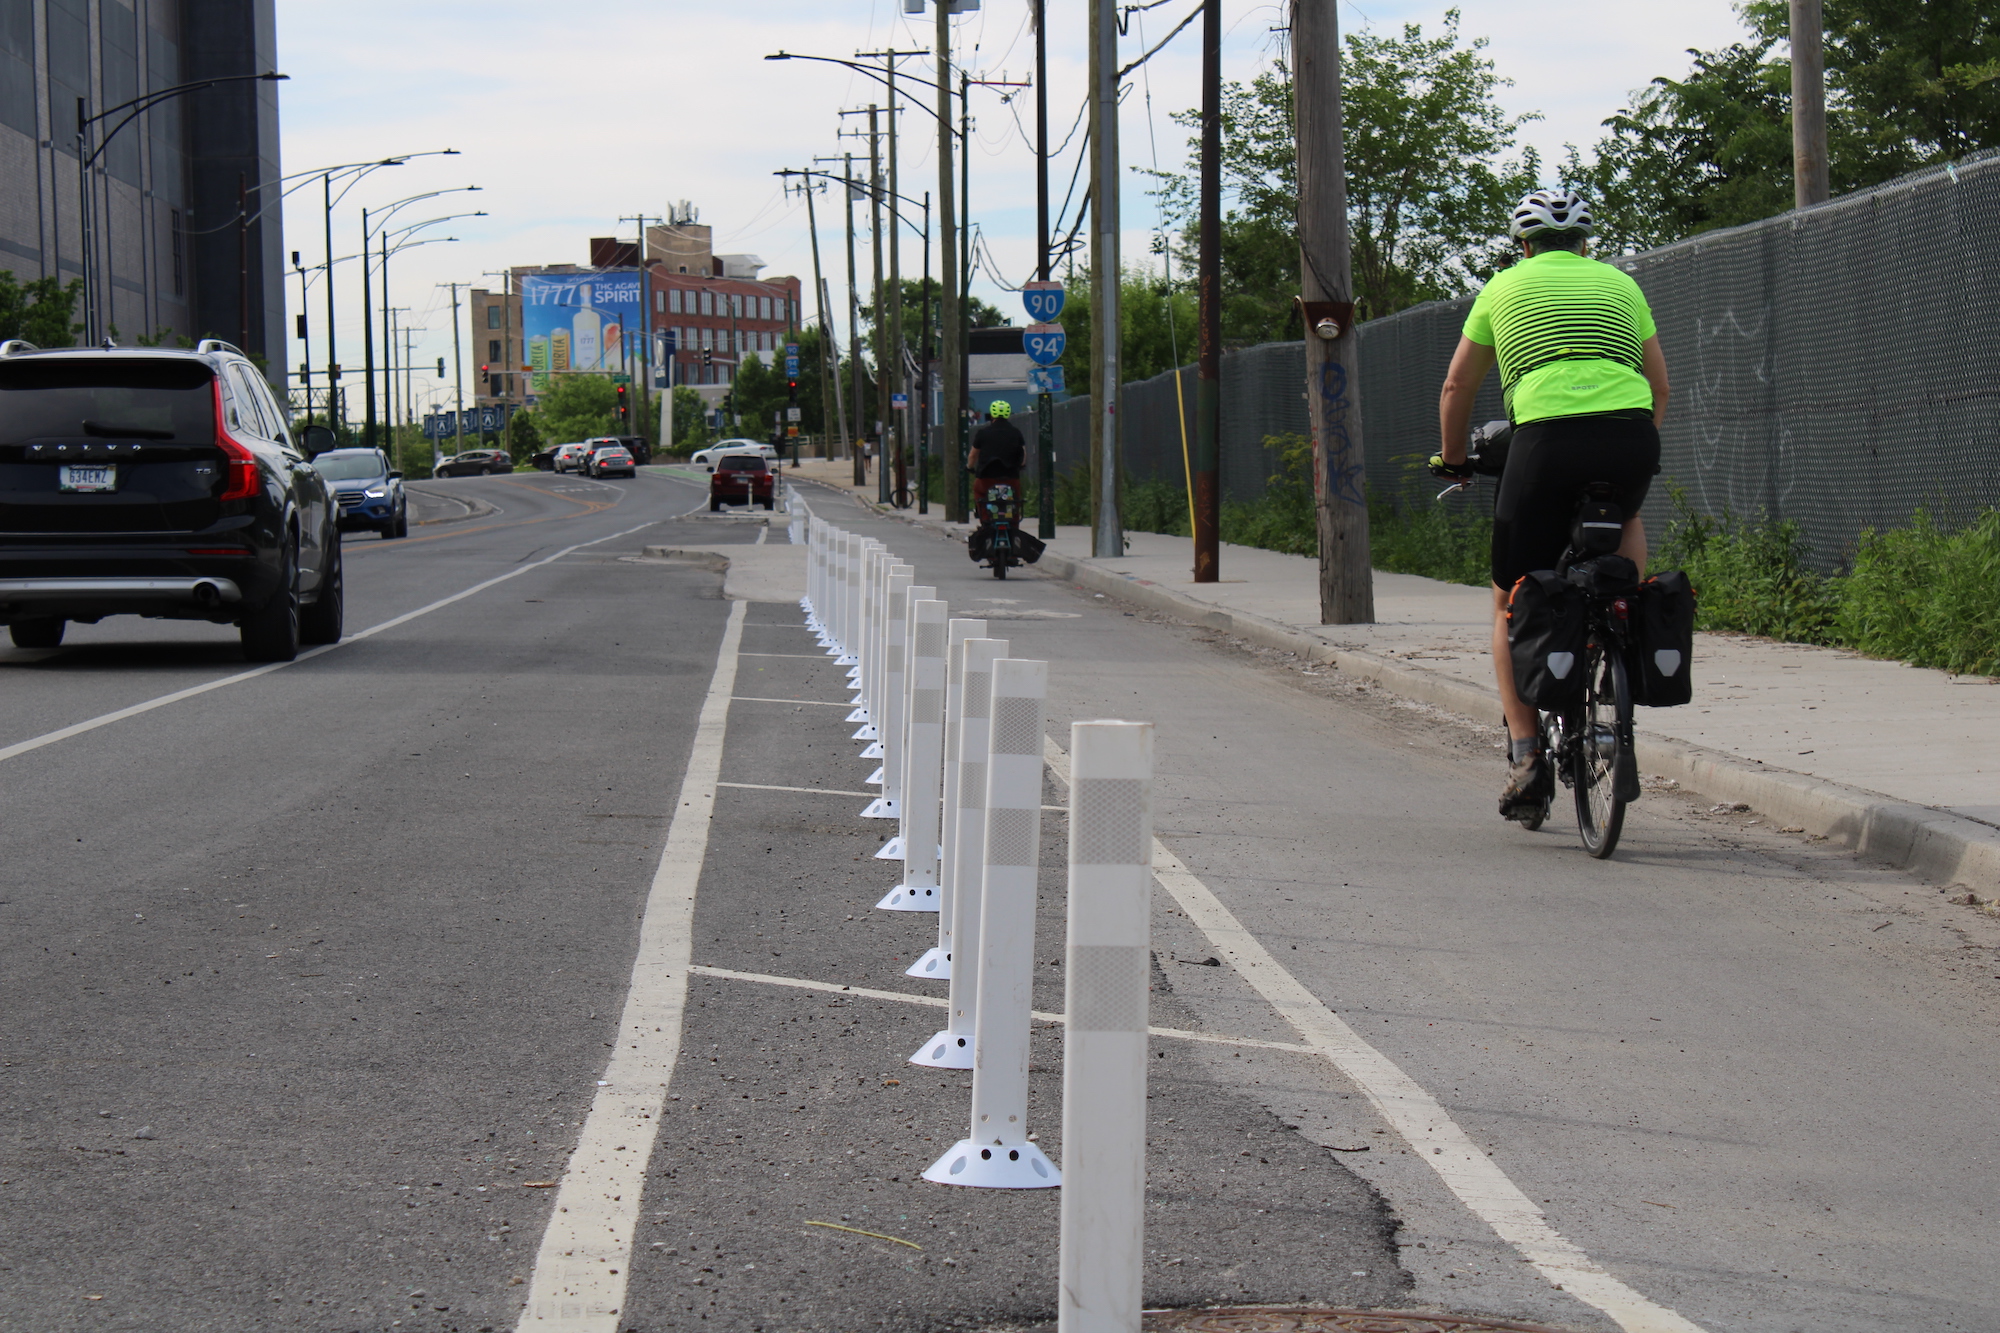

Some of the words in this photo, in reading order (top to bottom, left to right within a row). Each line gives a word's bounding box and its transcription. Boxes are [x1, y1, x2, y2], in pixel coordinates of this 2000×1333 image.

[531, 285, 577, 305] 1777
[595, 290, 641, 303] SPIRIT
[1031, 295, 1057, 314] 90
[1030, 337, 1058, 357] 94
